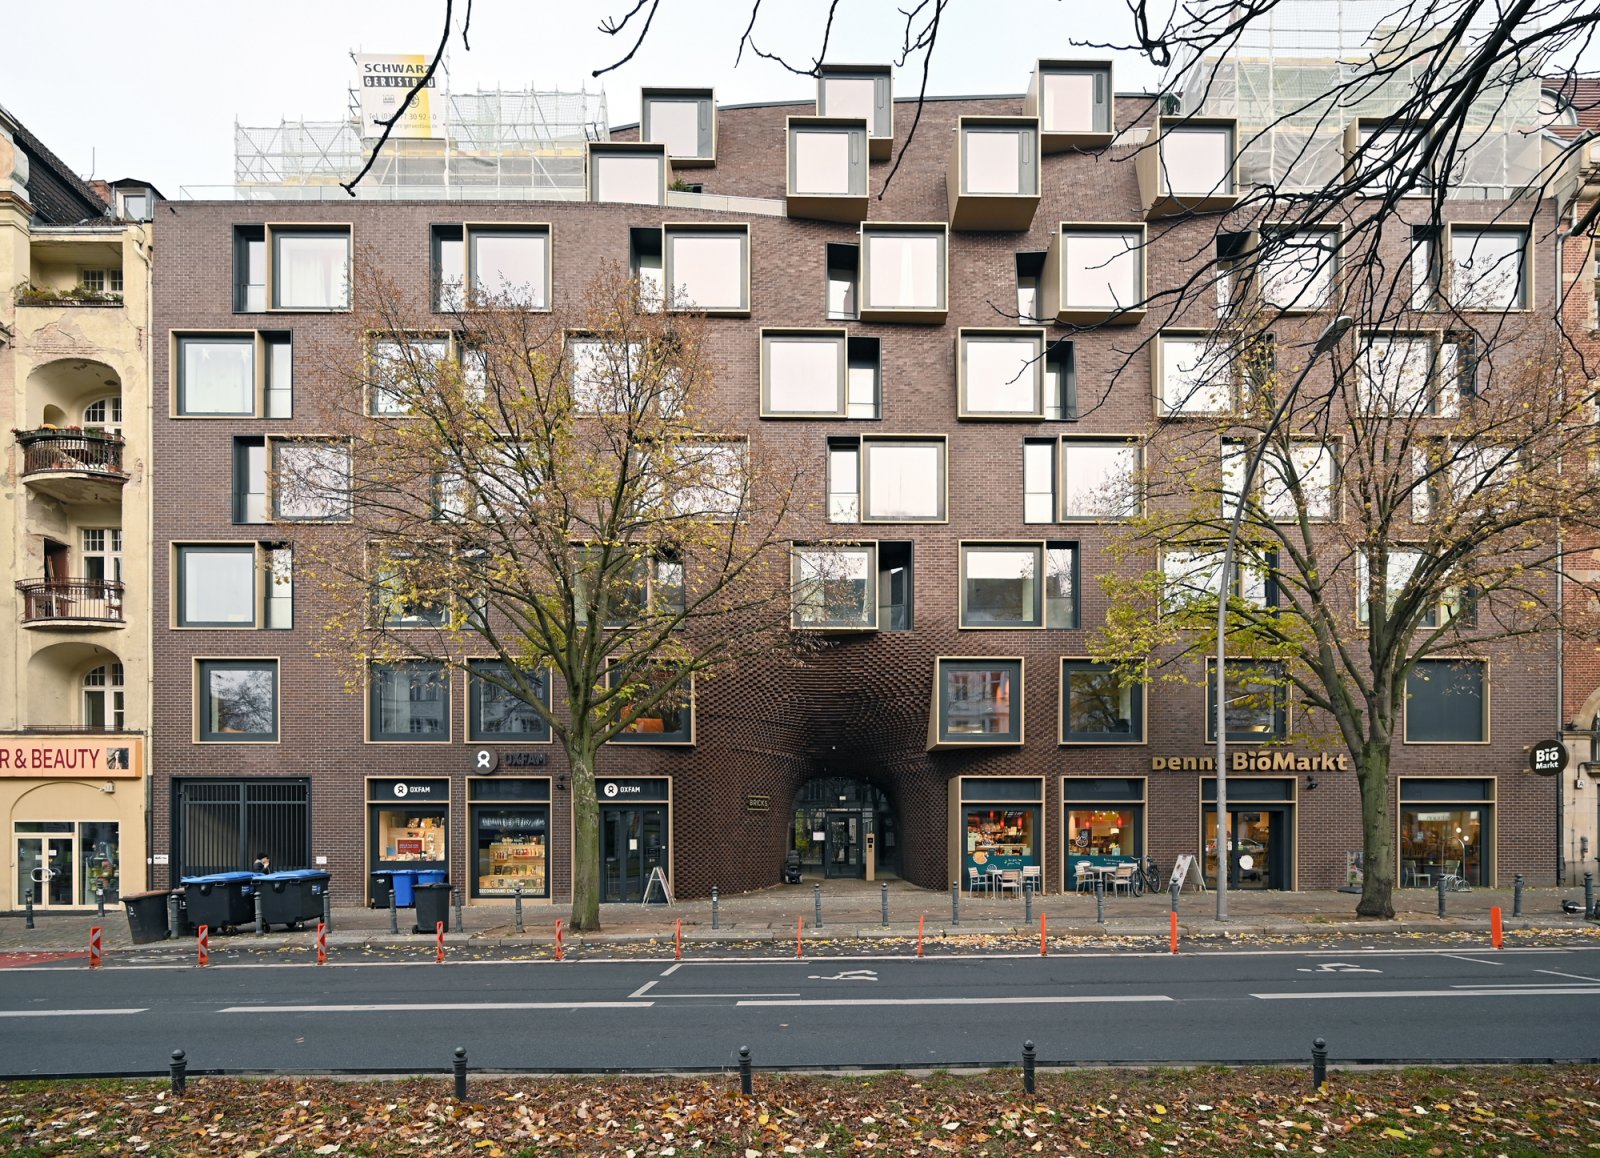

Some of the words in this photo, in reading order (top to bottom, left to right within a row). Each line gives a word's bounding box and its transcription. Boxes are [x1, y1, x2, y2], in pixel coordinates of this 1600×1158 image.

[14, 748, 27, 769] &
[32, 748, 100, 769] BEAUTY
[505, 752, 547, 766] OXFAM
[1232, 751, 1349, 771] BioMarkt
[1535, 747, 1559, 762] Bio
[1535, 761, 1559, 770] Markt
